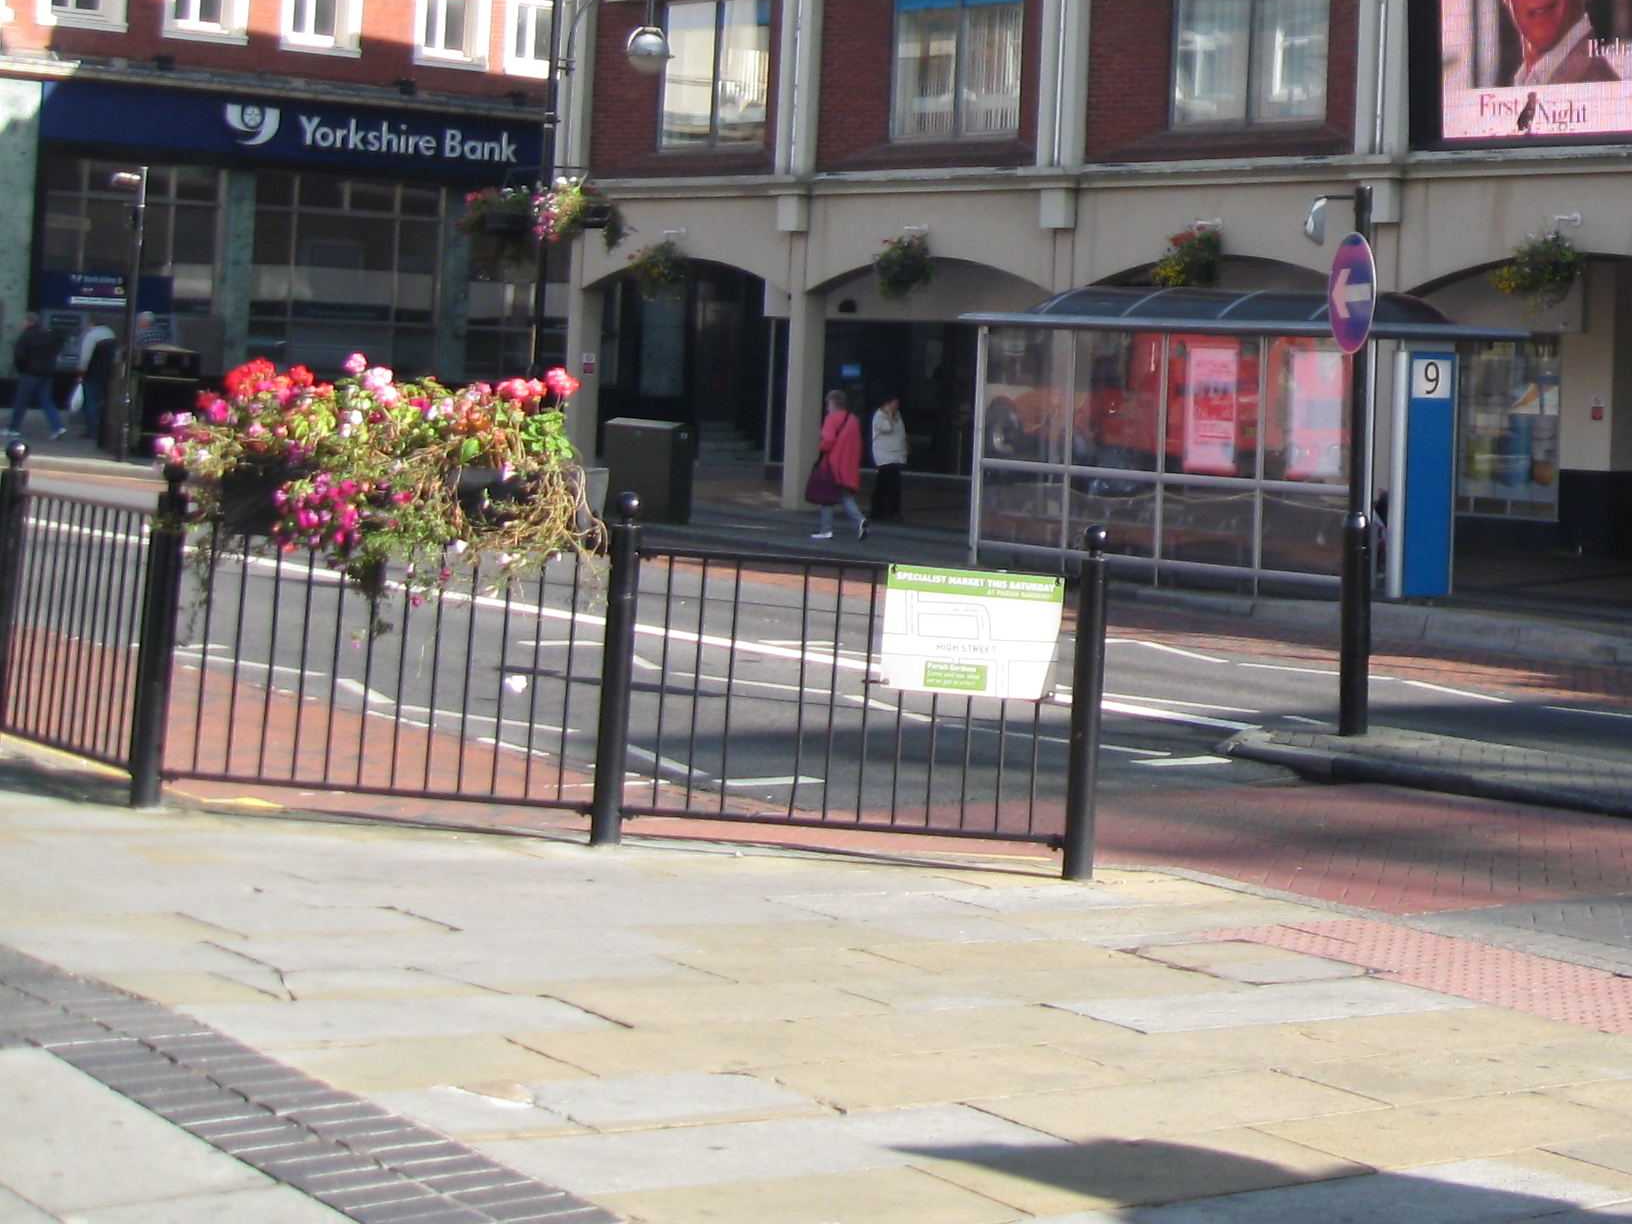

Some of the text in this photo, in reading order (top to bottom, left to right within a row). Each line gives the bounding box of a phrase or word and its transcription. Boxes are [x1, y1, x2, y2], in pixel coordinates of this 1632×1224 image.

[1479, 93, 1519, 118] First
[1536, 99, 1588, 131] Night
[299, 115, 518, 164] Yorkshire Bank
[1424, 361, 1440, 395] 9
[896, 571, 1056, 593] SPECIALIST MARKET THIS SATURDAY
[936, 643, 996, 654] HIGH STREET
[927, 662, 977, 673] Parish Gardens
